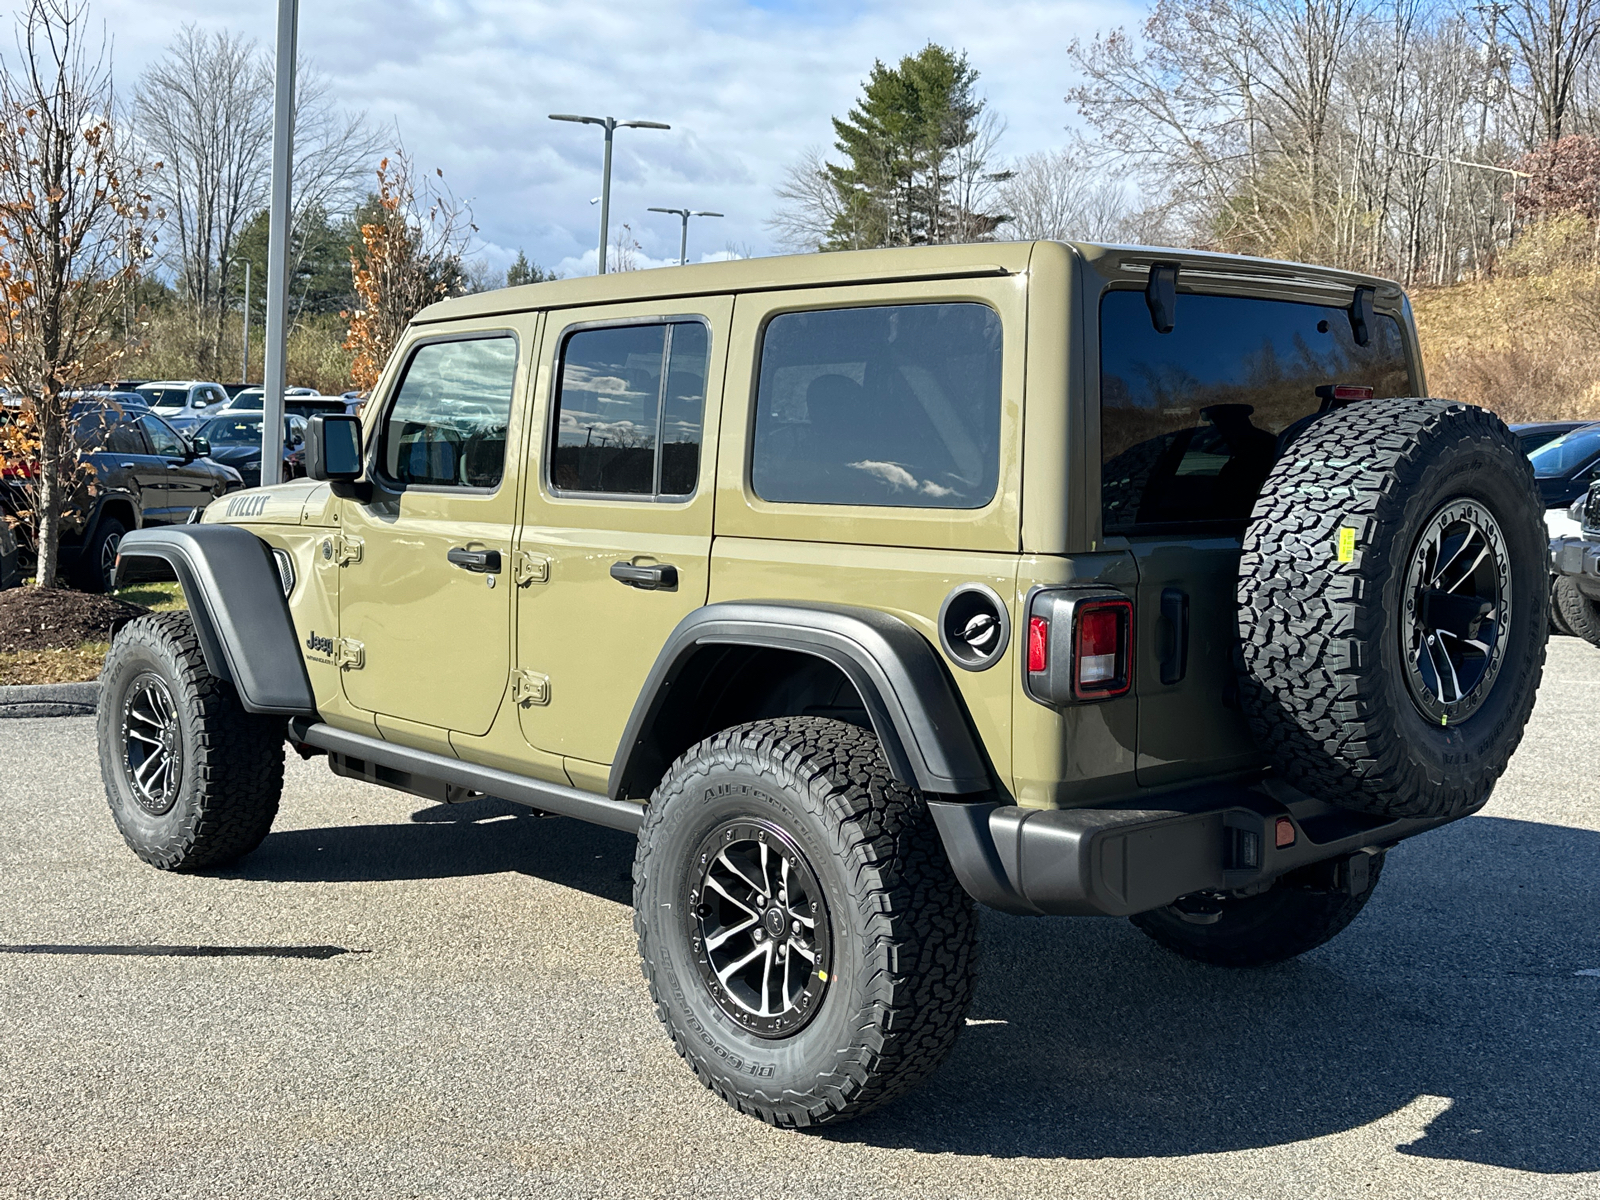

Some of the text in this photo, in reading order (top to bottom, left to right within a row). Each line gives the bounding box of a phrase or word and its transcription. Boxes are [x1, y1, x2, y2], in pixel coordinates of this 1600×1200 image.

[225, 495, 271, 517] WILLYS
[306, 630, 333, 657] Jeep
[660, 947, 776, 1080] BFGoodrich
